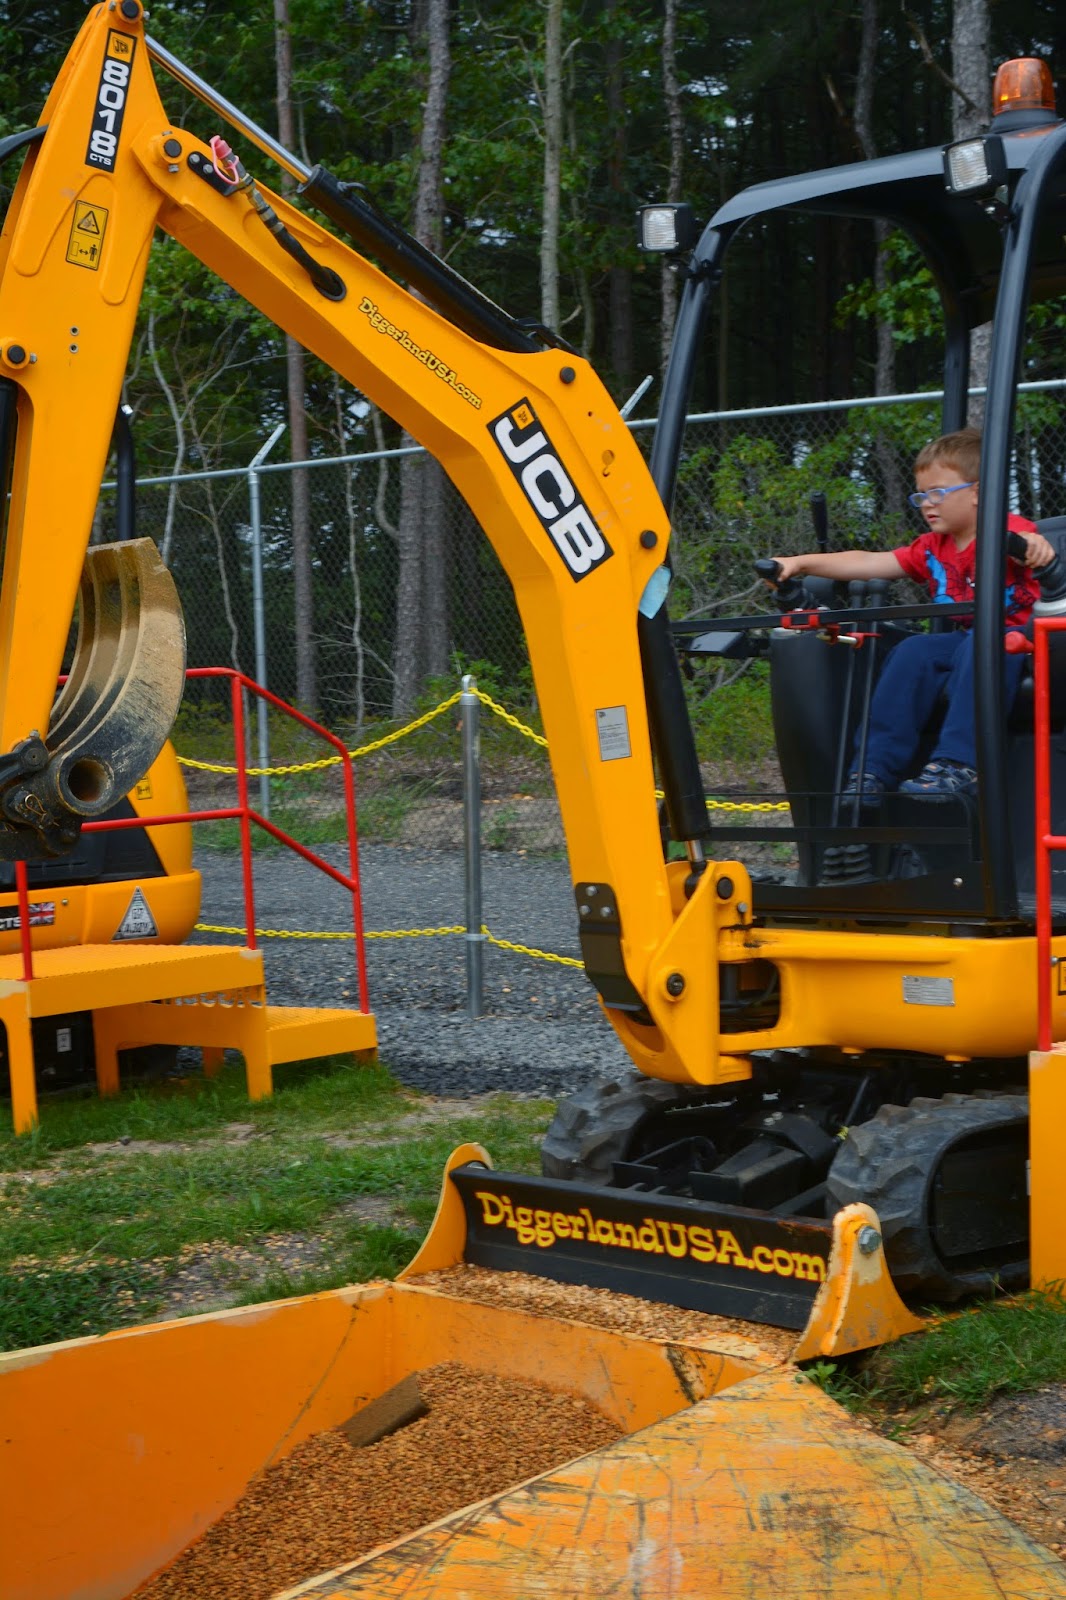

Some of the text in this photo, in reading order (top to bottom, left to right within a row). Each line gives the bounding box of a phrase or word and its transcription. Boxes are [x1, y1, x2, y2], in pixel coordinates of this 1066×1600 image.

[90, 59, 130, 157] 8018
[89, 152, 112, 166] CTS
[358, 297, 483, 410] DiggerlandUSA.com
[494, 416, 606, 574] JCB
[474, 1191, 827, 1282] DiggerlandUSA.com
